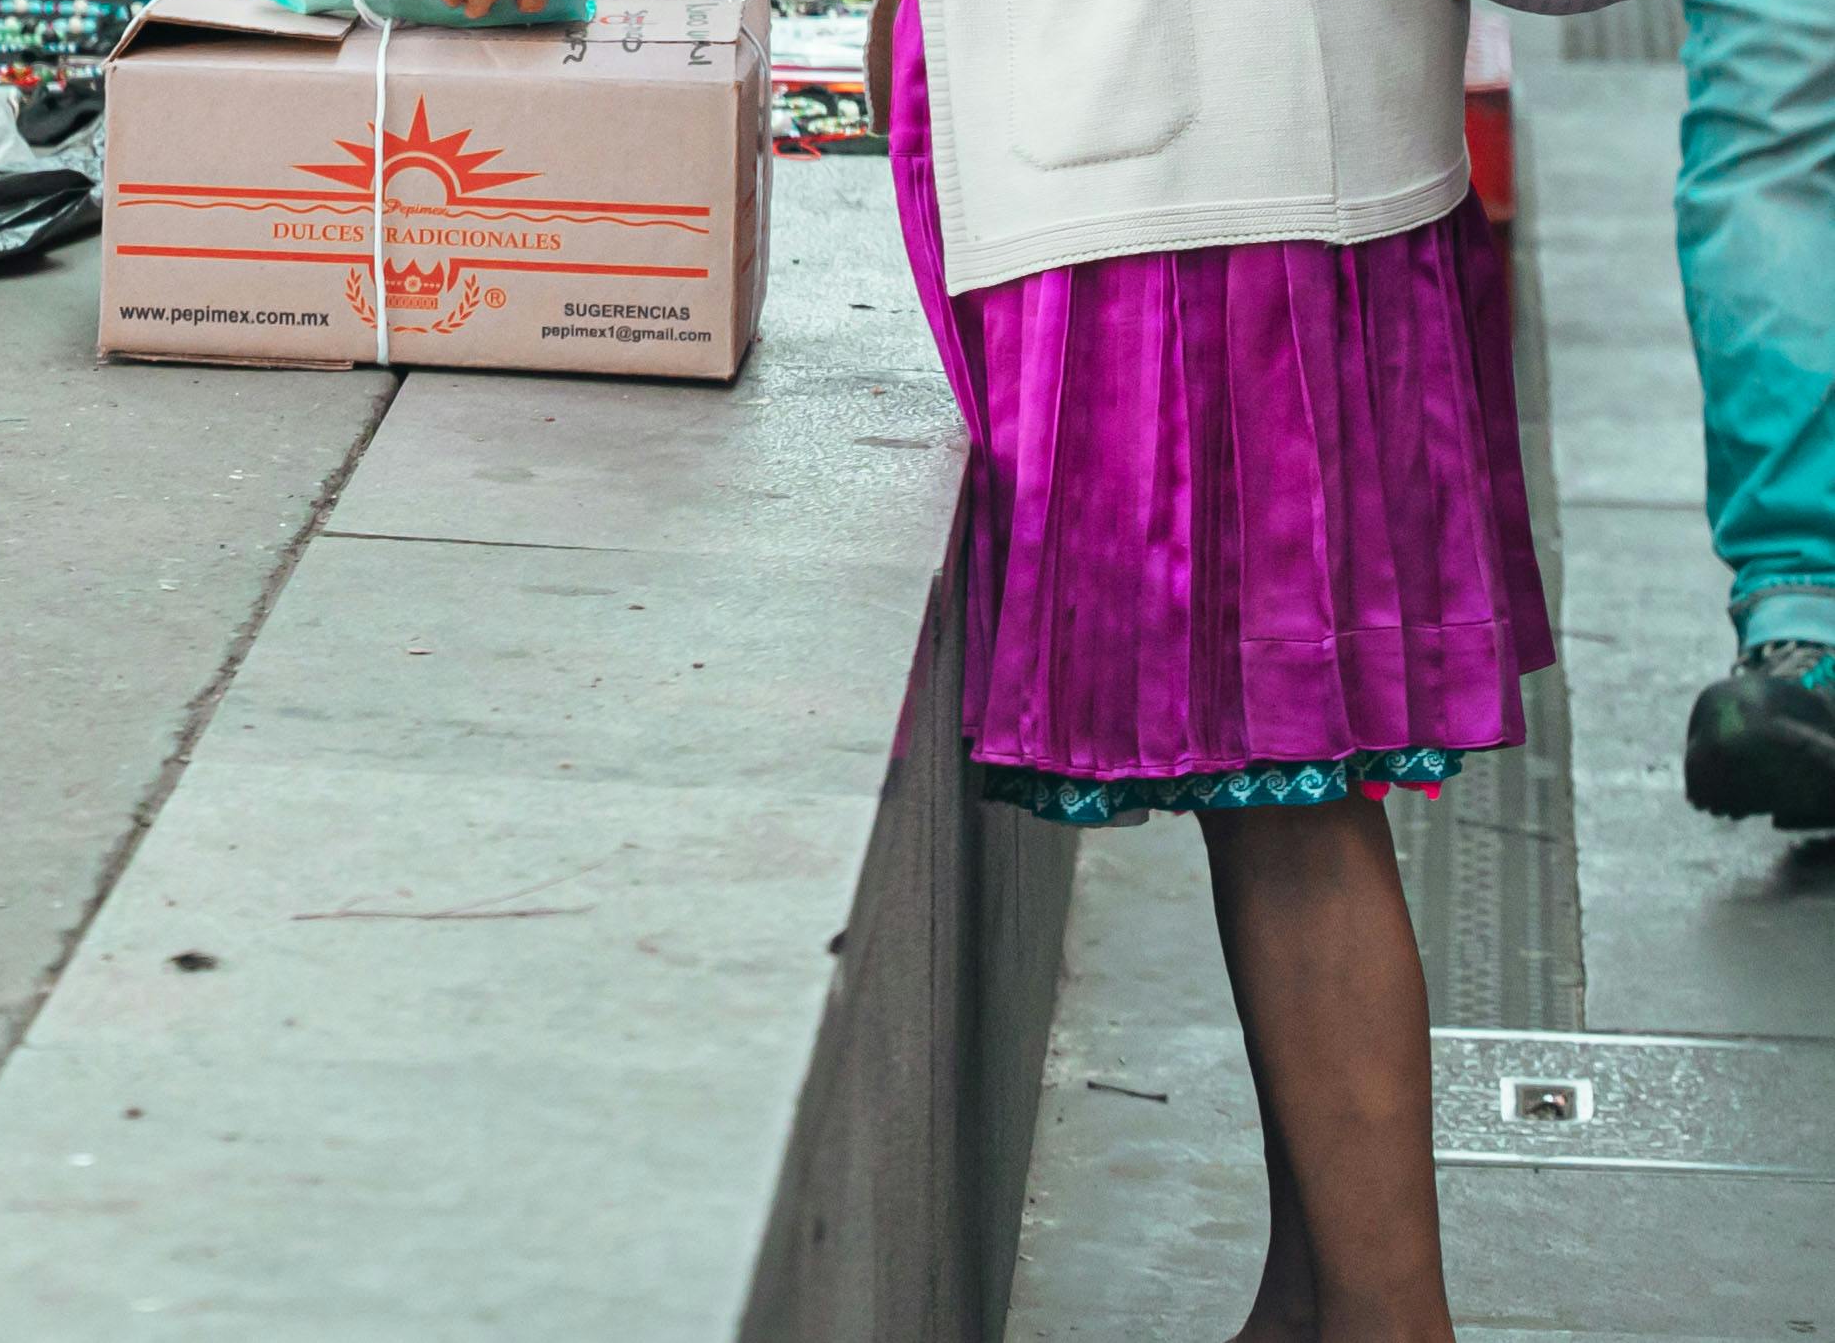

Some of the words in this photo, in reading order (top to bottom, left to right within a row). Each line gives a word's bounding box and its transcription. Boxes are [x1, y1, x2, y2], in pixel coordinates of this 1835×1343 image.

[273, 222, 365, 243] DULCES
[119, 305, 330, 327] www.pepimex.com.mx
[564, 302, 691, 321] SUGERENCIAS
[541, 325, 712, 343] pepimex1@gmail.com
